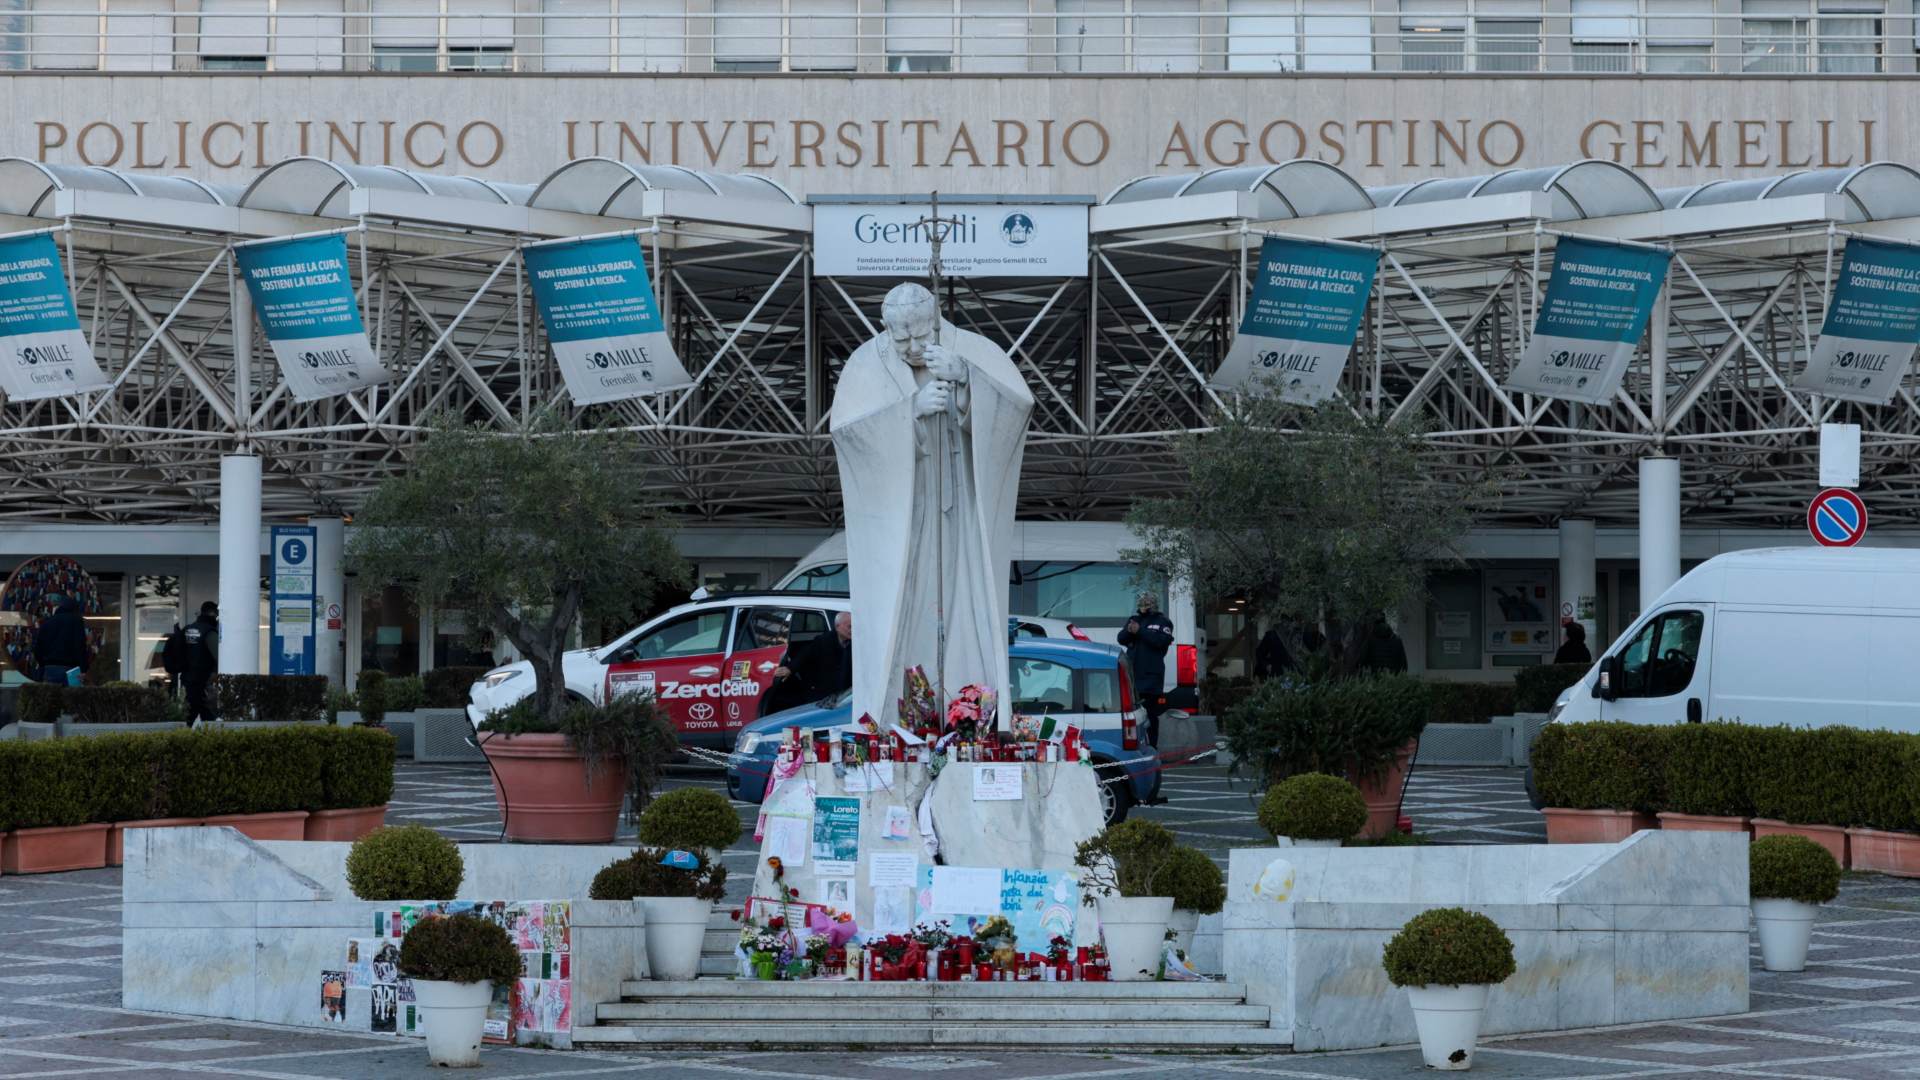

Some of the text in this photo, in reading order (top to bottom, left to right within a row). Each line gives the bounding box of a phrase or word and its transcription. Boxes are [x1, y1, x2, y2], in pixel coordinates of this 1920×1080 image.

[33, 118, 1879, 169] POLICLINICO UNIVERSITARIO AGOSTINO GEMELLI
[855, 213, 976, 243] Gemelli
[252, 258, 343, 278] NON FERMARE LA CURA,
[857, 256, 893, 264] Fondazione
[895, 256, 928, 264] Policlinico
[538, 260, 636, 279] NON FERMARE LA SPERANZA,
[1268, 261, 1364, 283] NON FERMARE LA CURA,
[1560, 261, 1652, 282] NON FERMARE LA SPERANZA,
[1849, 261, 1868, 274] NON
[1869, 264, 1904, 278] FERMARE
[1904, 270, 1914, 280] LA
[261, 280, 293, 290] SOSTIENI
[294, 278, 305, 288] LA
[554, 274, 626, 290] SOSTIENI LA RICERCA.
[1269, 276, 1355, 294] SOSTIENI LA RICERCA.
[1570, 276, 1599, 288] SOSTIENI
[1600, 280, 1608, 289] LA
[1850, 276, 1885, 290] SOSTIENI
[1885, 281, 1895, 290] LA
[290, 544, 299, 559] E
[833, 805, 858, 814] Loreto
